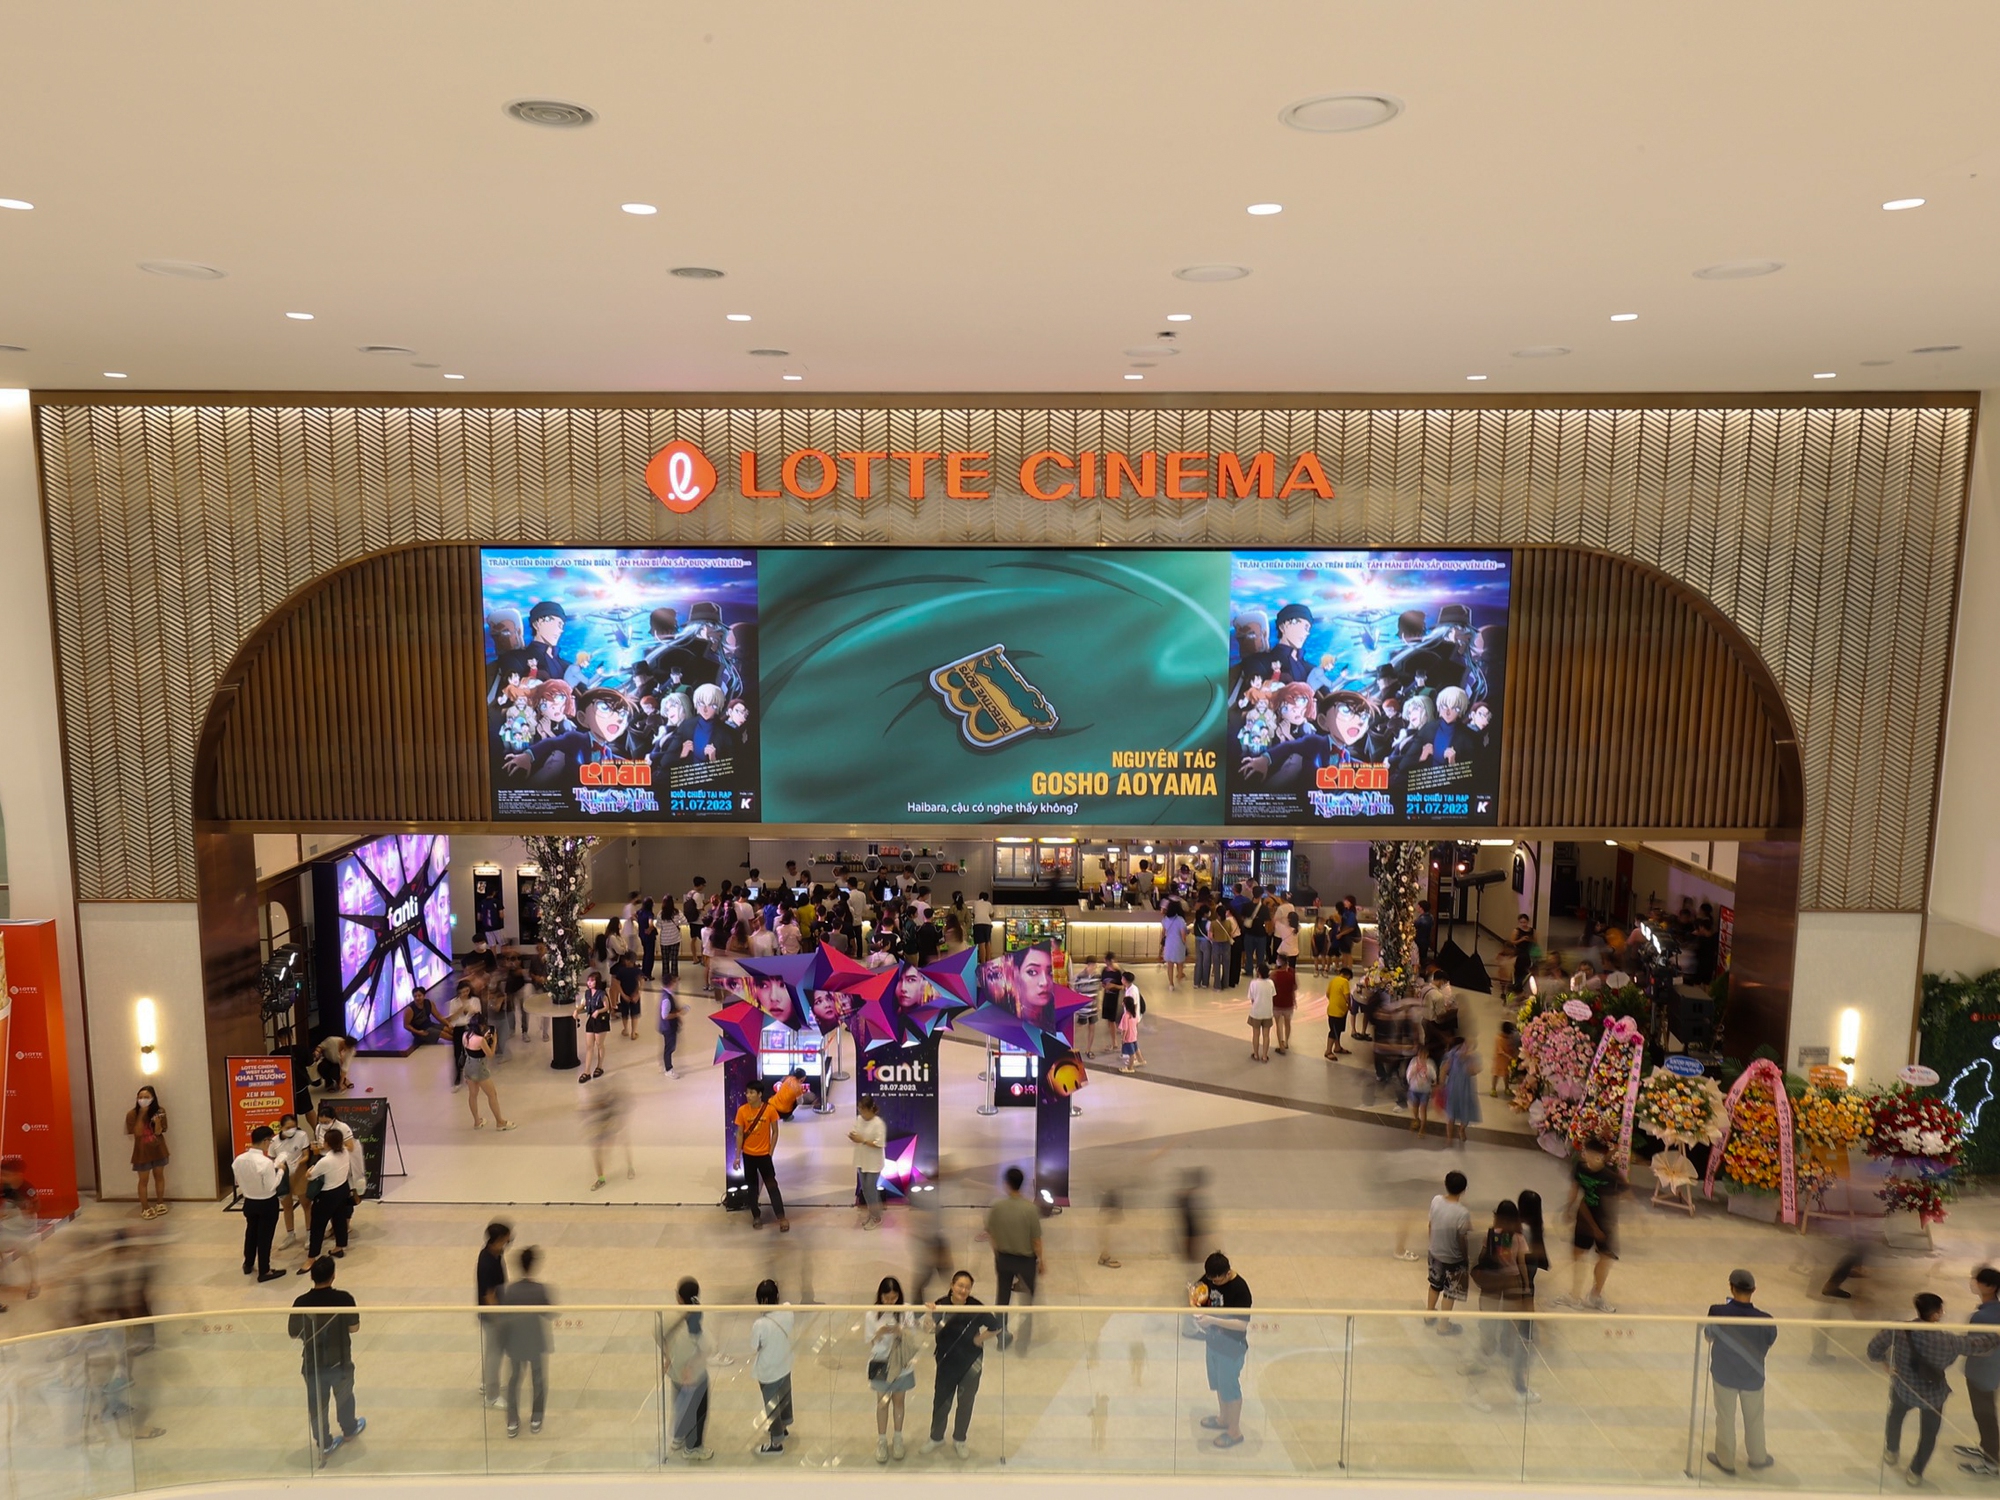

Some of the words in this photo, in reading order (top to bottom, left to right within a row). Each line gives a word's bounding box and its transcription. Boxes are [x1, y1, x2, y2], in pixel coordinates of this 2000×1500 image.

[740, 448, 990, 499] LOTTE
[1019, 449, 1335, 501] CINEMA
[958, 665, 979, 688] BOYS
[975, 686, 1012, 734] DETECTIVE
[1111, 748, 1179, 768] NGUYÊN
[1184, 748, 1217, 768] TÁC
[1031, 771, 1109, 796] GOSHO
[1116, 772, 1218, 796] AOYAMA
[670, 800, 732, 811] 21.07.2023
[707, 791, 717, 799] TẠI
[719, 791, 732, 799] RẠP
[1444, 794, 1454, 803] TẠI
[1456, 794, 1469, 803] RẠP
[907, 801, 949, 814] Haibara,
[951, 803, 970, 814] cậu
[972, 801, 984, 813] có
[986, 802, 1014, 815] nghe
[1015, 801, 1038, 815] thấy
[1040, 801, 1078, 815] không?
[1406, 803, 1469, 814] 21.07.2023
[387, 895, 418, 930] fanti
[863, 1060, 929, 1082] fanti
